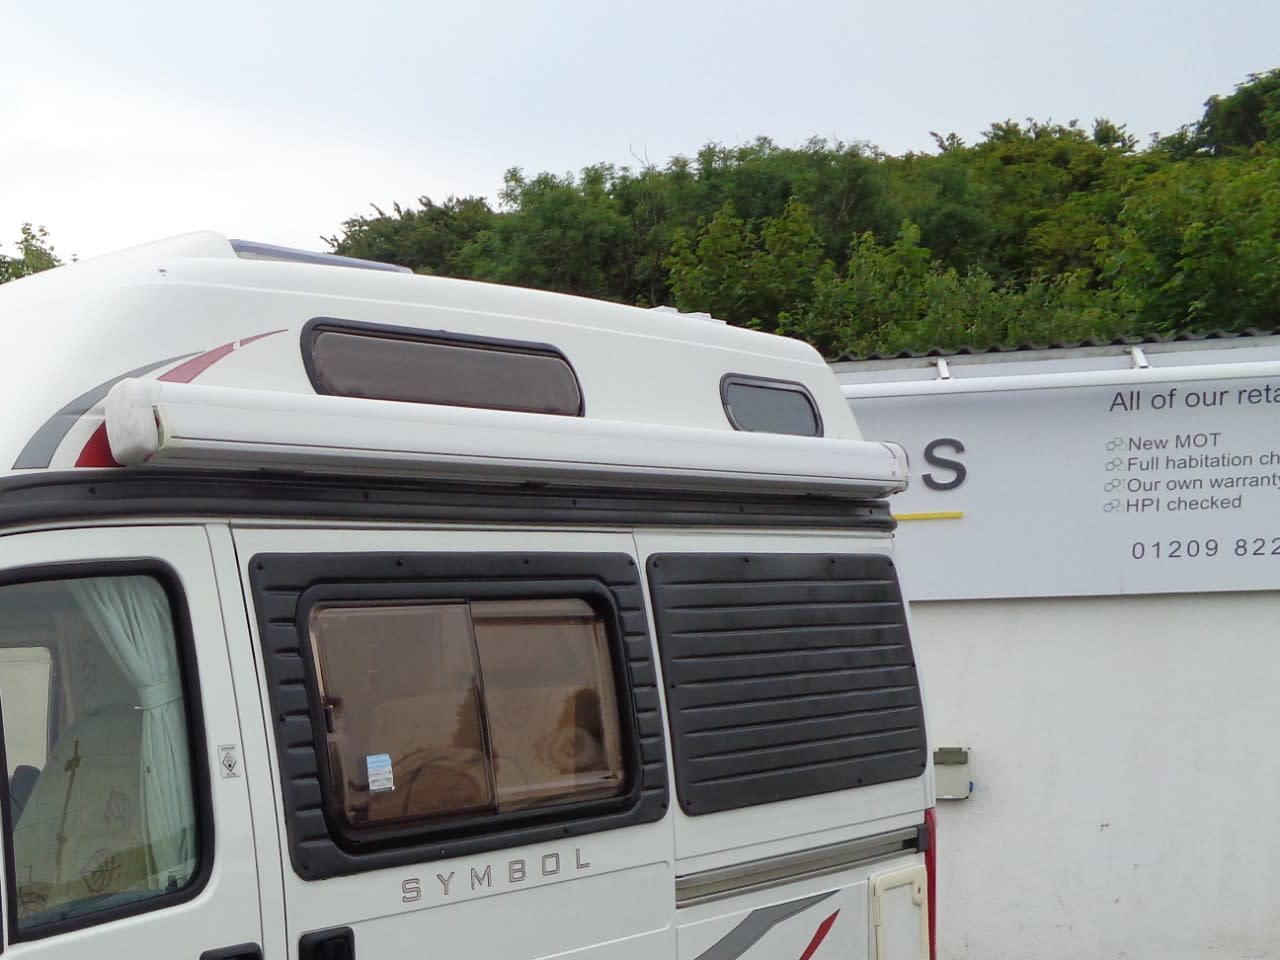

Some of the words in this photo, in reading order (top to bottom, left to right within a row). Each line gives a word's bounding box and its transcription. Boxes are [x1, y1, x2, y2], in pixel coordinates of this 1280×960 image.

[1109, 390, 1141, 413] All
[1151, 388, 1177, 410] of
[1185, 390, 1229, 408] our
[1128, 436, 1169, 452] New
[1175, 432, 1222, 449] MOT
[1127, 455, 1159, 472] Full
[1166, 453, 1253, 470] habitation
[1127, 478, 1161, 493] Our
[1166, 477, 1203, 491] own
[1209, 472, 1280, 490] warrant
[1126, 497, 1160, 513] HPI
[1167, 494, 1242, 512] checked
[1132, 538, 1219, 560] 01209
[1234, 537, 1280, 557] 822
[401, 848, 591, 904] SYMBOL
